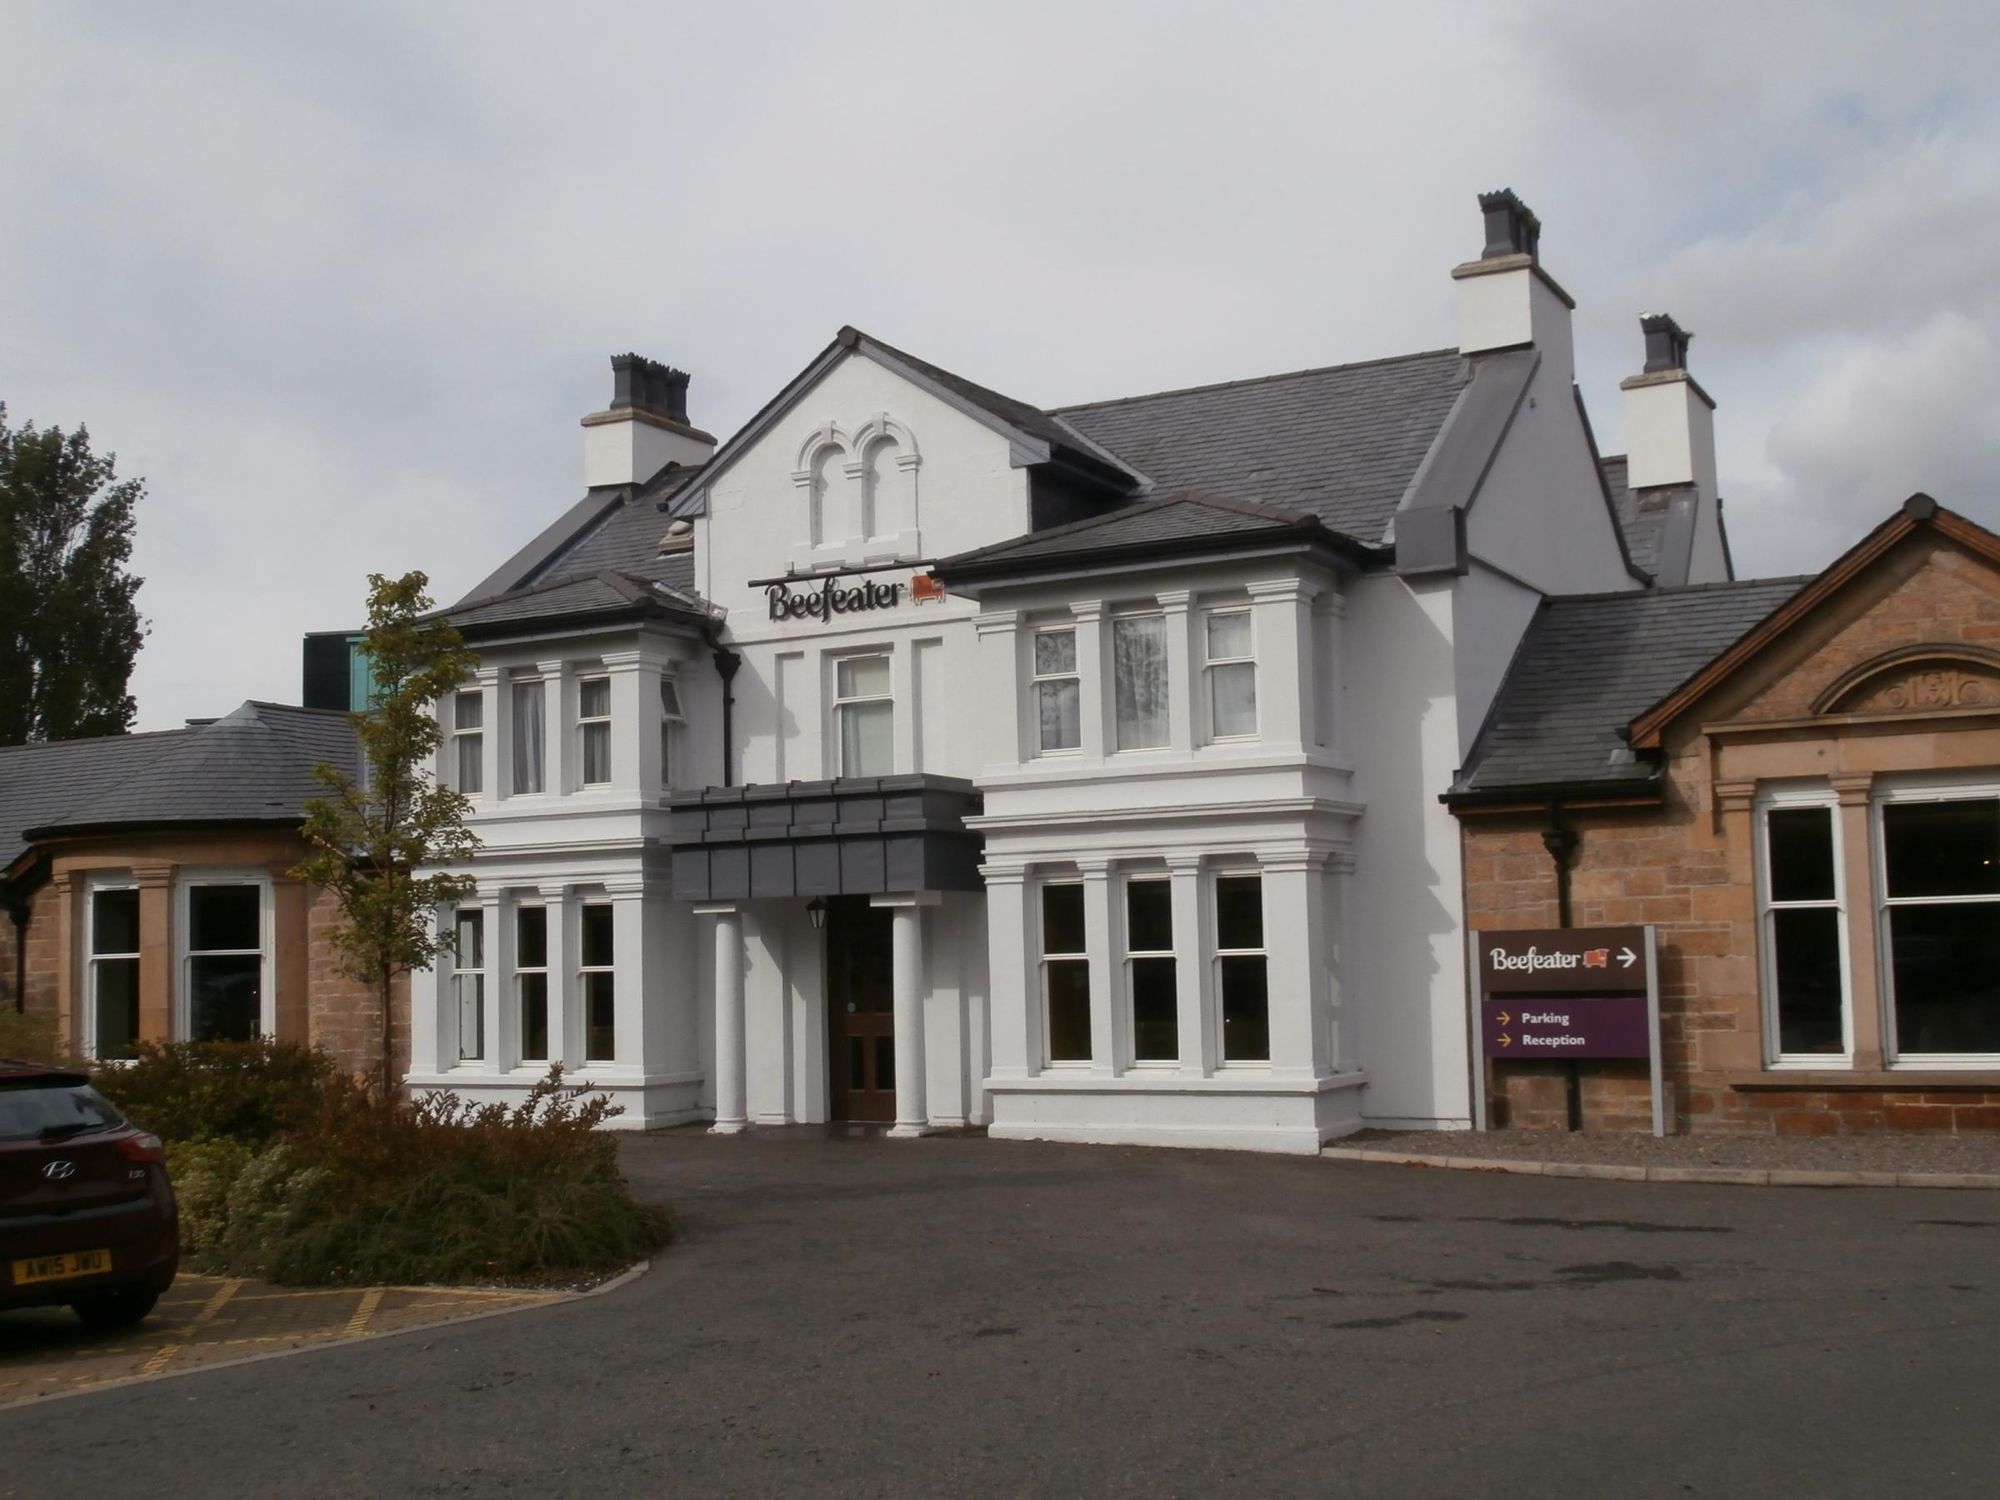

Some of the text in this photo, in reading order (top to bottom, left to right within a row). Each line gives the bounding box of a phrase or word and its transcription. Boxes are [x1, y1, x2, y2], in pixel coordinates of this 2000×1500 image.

[765, 576, 904, 623] Beefeater
[1490, 946, 1581, 974] Beefeater
[1521, 1012, 1570, 1026] Parking
[1522, 1034, 1586, 1048] Reception
